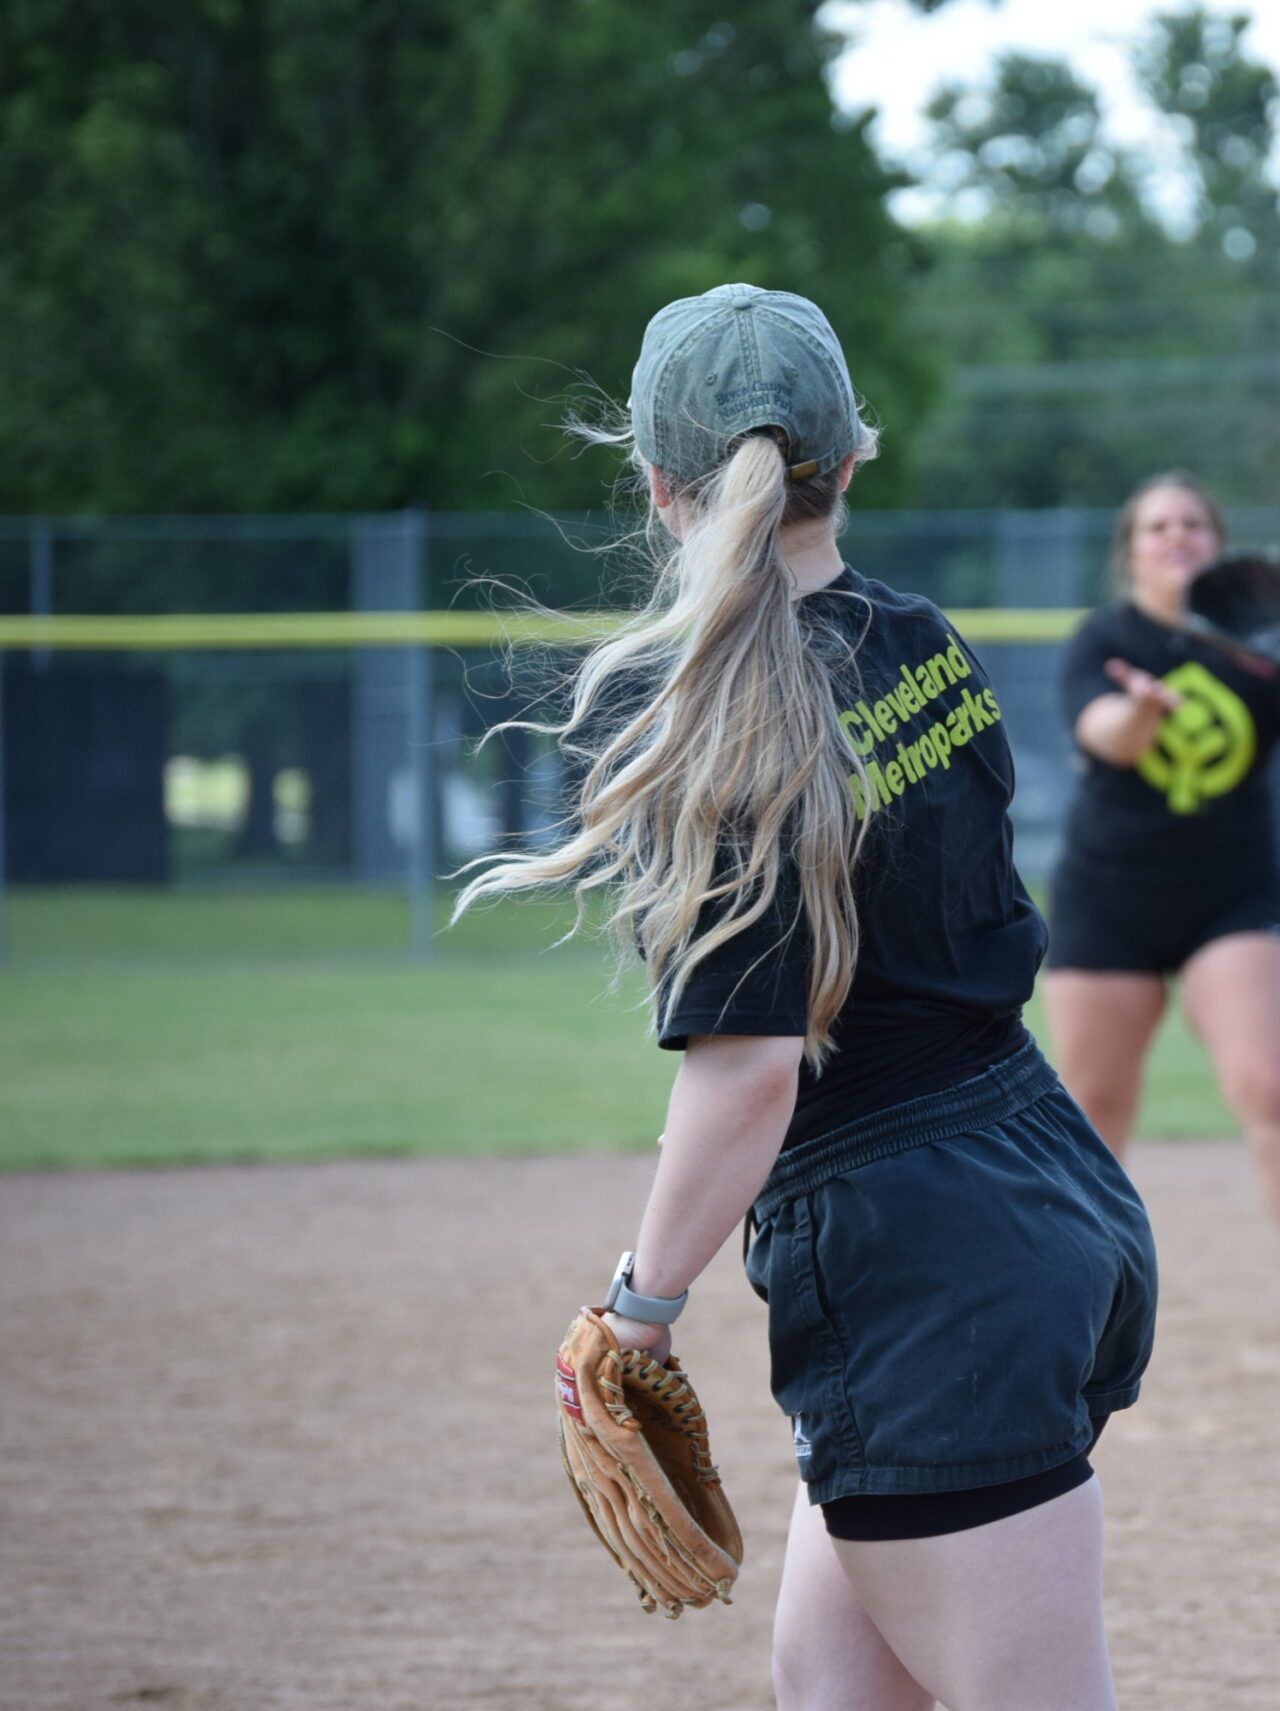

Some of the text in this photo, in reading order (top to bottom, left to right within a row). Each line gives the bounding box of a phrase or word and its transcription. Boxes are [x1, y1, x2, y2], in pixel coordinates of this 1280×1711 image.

[718, 393, 770, 419] National
[838, 633, 972, 756] Cleveland
[848, 688, 1002, 820] Metroparks
